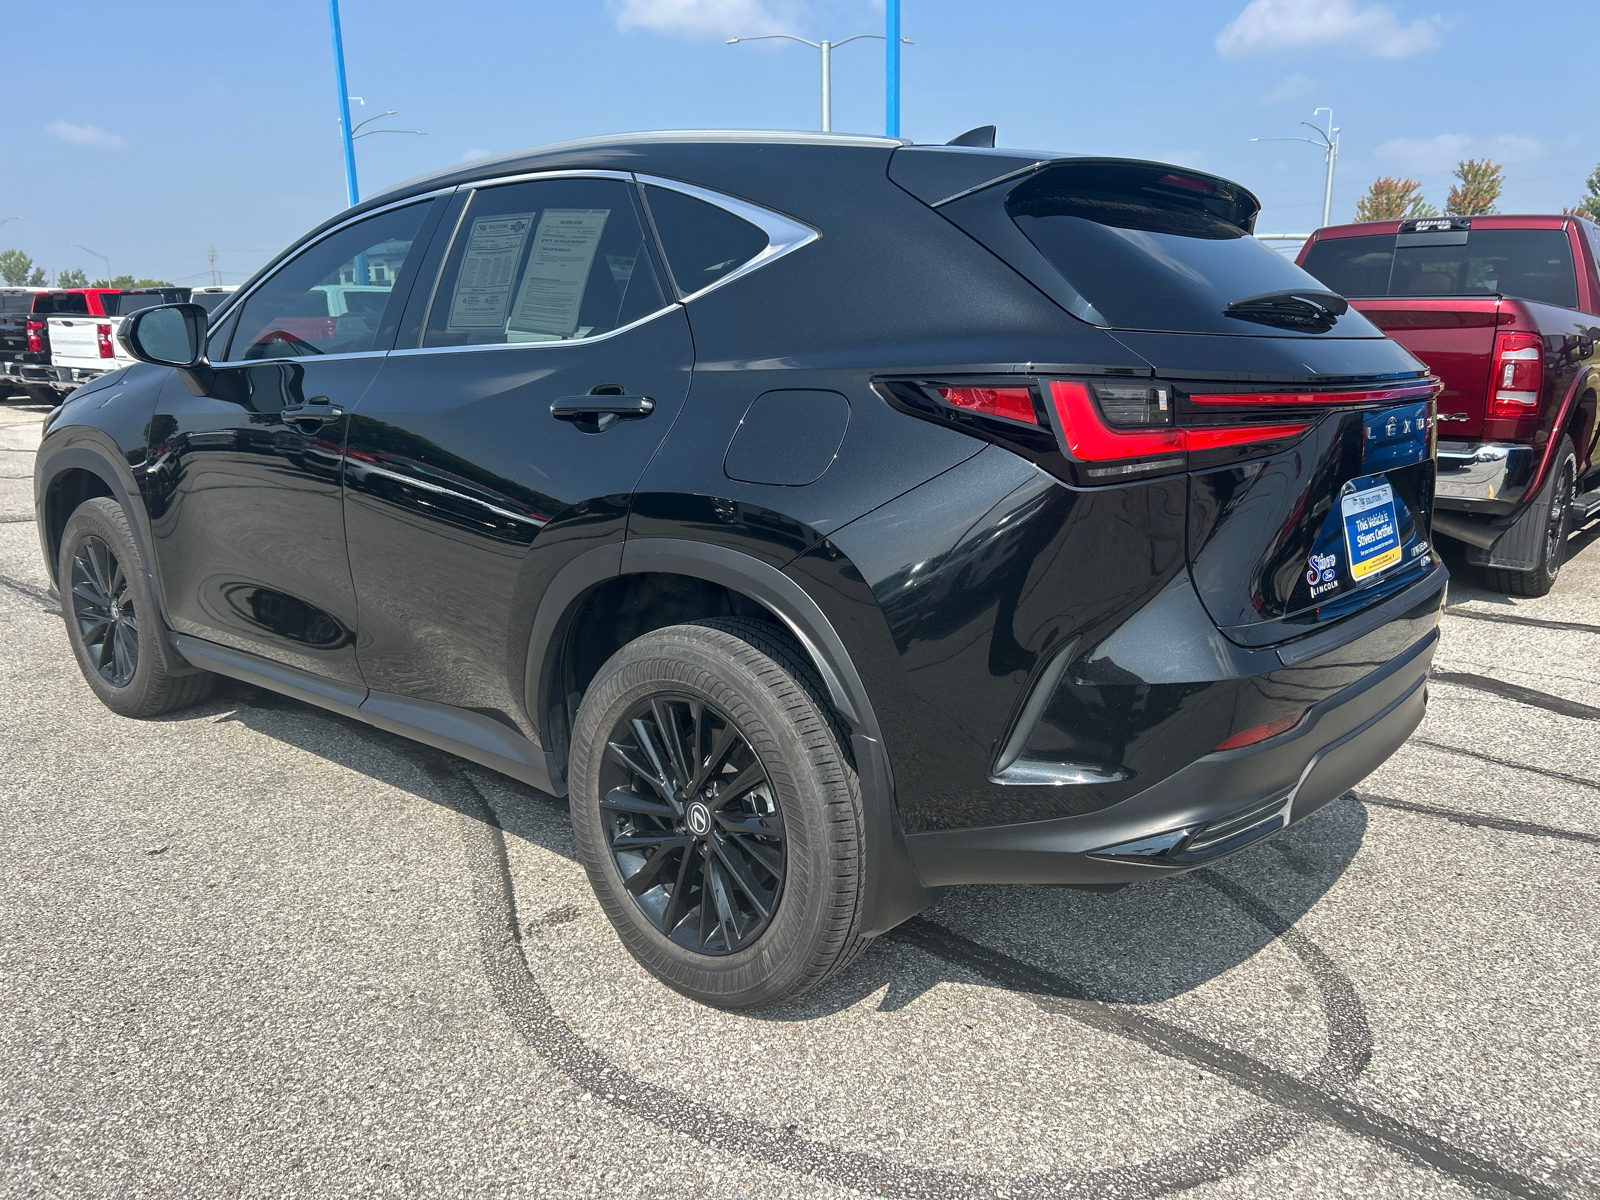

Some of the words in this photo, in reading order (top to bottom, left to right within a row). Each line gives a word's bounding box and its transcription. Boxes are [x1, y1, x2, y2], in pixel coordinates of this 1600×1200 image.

[1356, 518, 1368, 532] This
[1367, 512, 1384, 528] Vehicle
[1383, 510, 1388, 522] is
[1357, 533, 1375, 547] Stivers
[1375, 523, 1393, 540] Certified
[1310, 580, 1338, 598] LINCOLN
